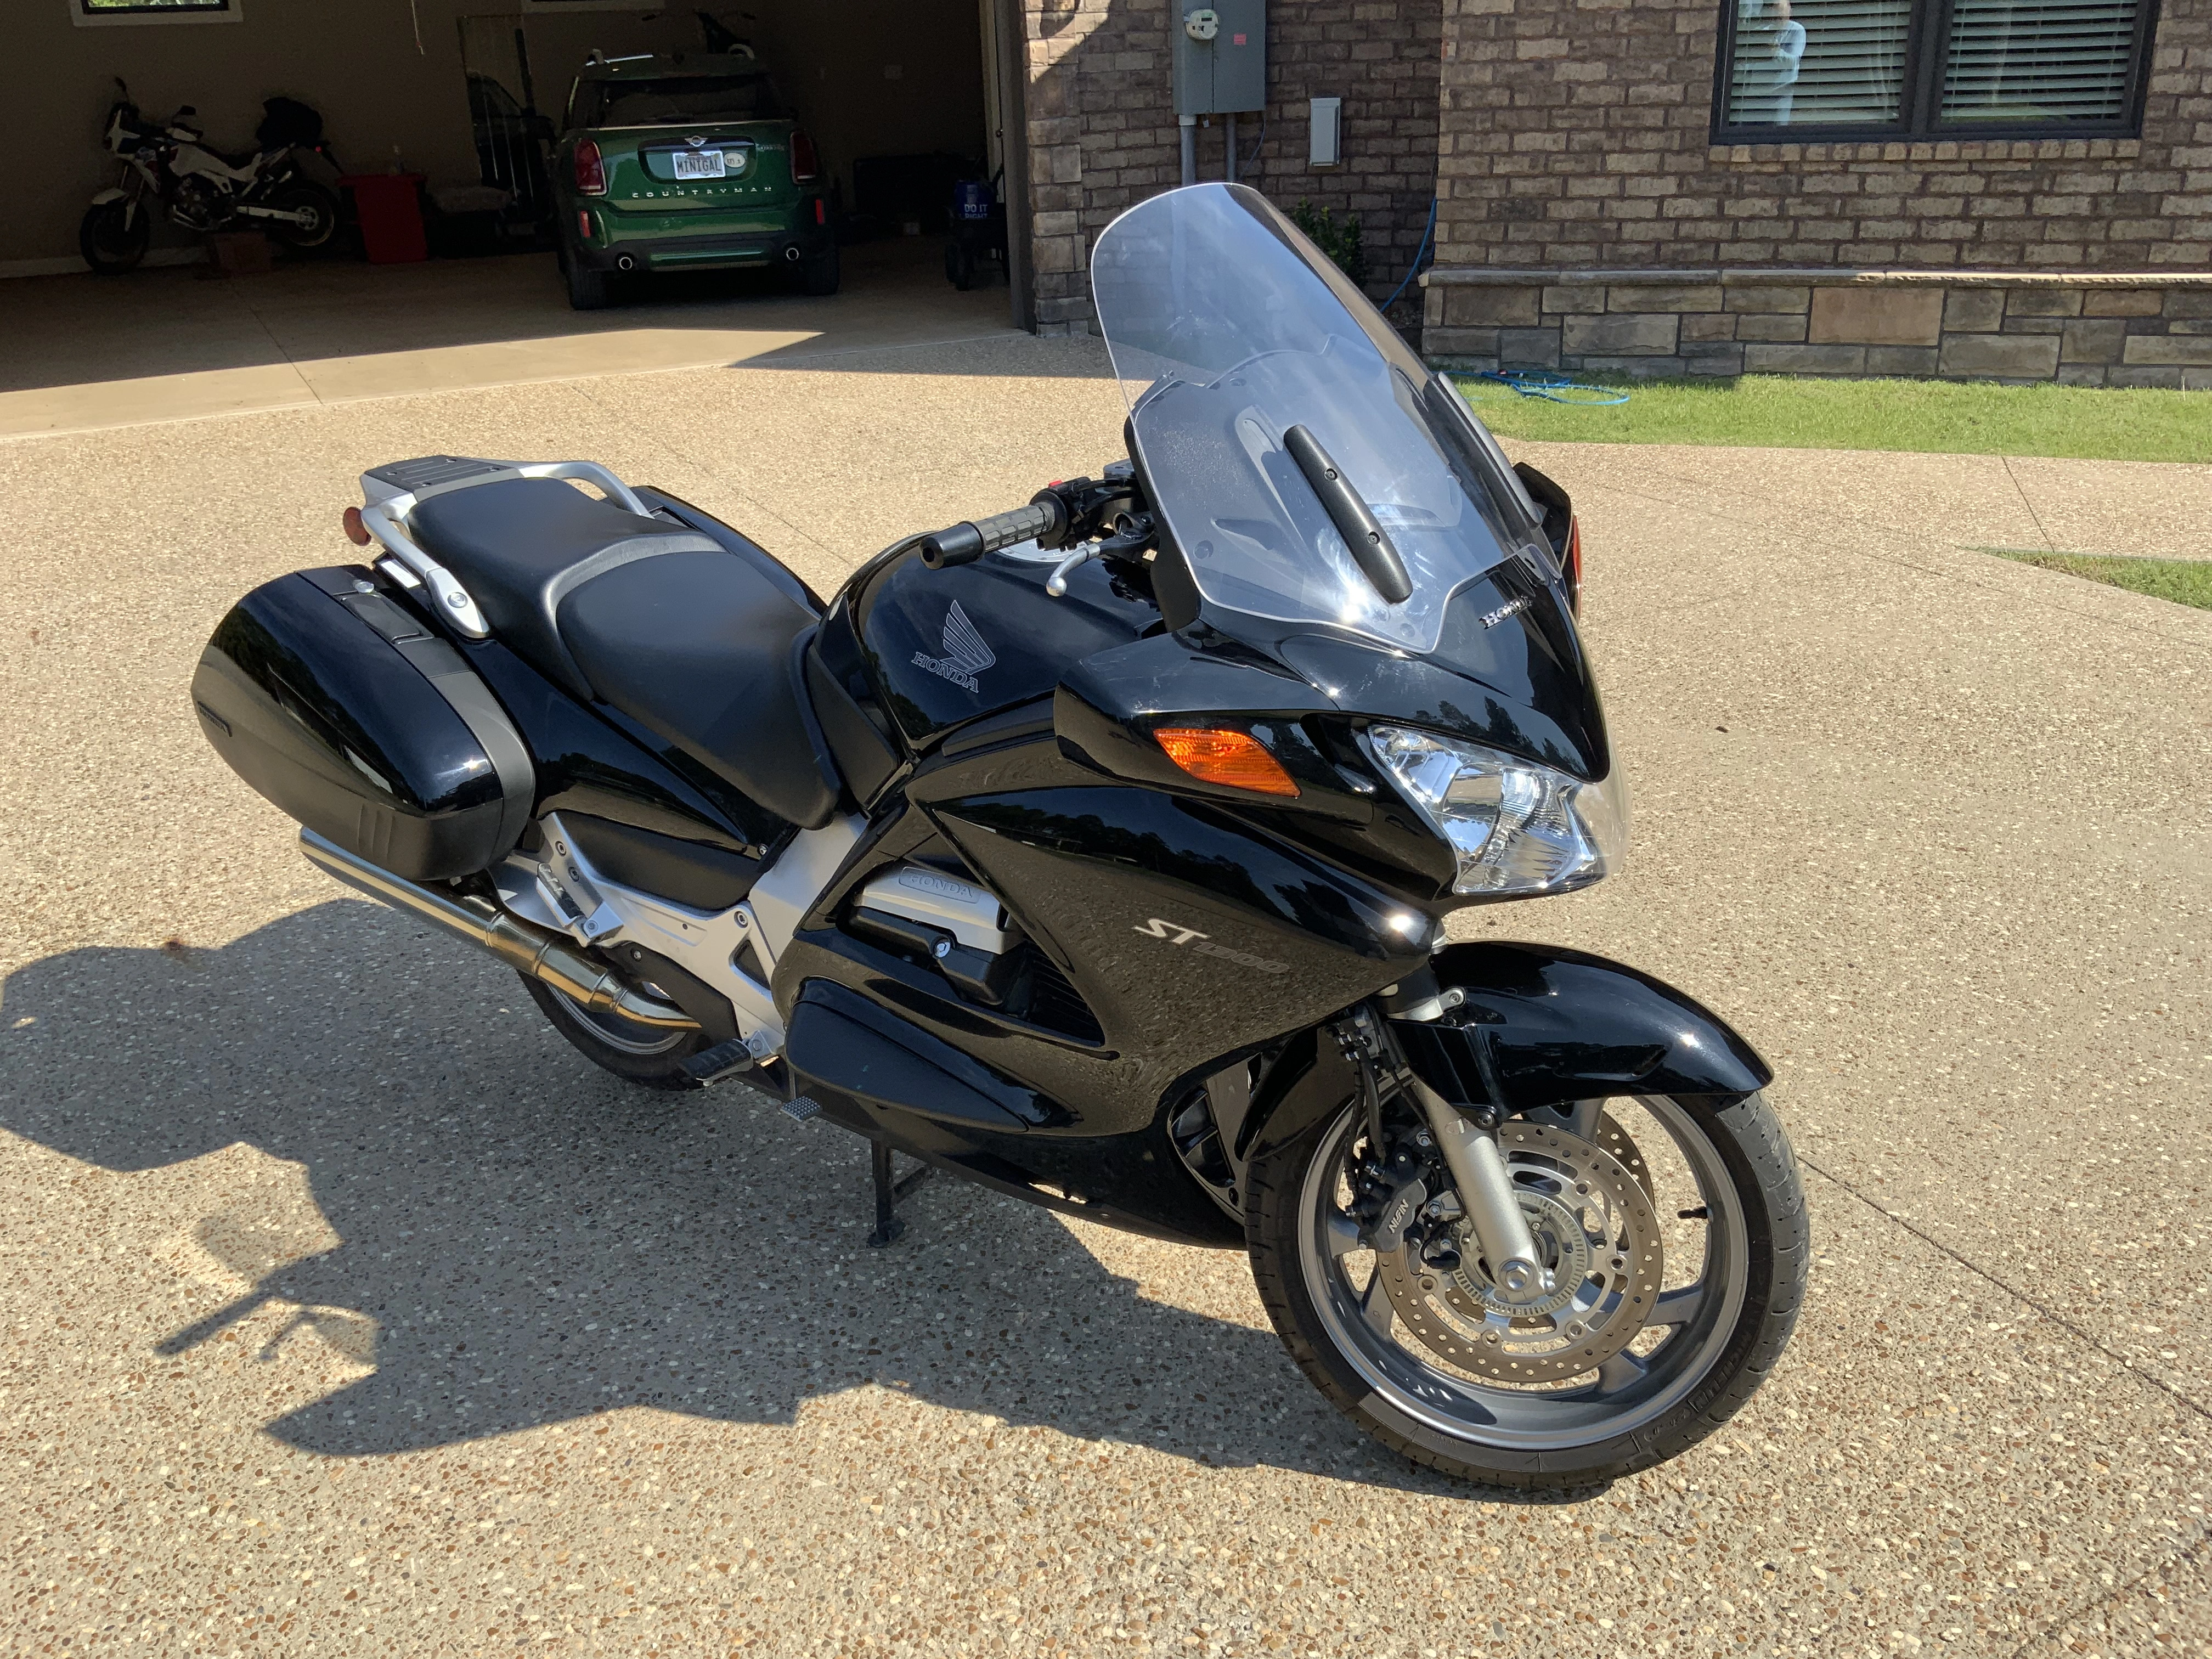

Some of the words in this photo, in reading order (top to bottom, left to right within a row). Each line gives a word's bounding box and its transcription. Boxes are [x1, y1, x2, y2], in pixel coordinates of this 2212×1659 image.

[677, 159, 721, 173] MINIGAL
[632, 187, 772, 198] COUNTRYMAN
[964, 204, 977, 213] DO
[979, 204, 988, 213] IT
[1480, 595, 1532, 628] HONDA
[911, 651, 979, 693] HONDA
[911, 875, 972, 898] HONDA
[1389, 1198, 1409, 1233] NISSIN
